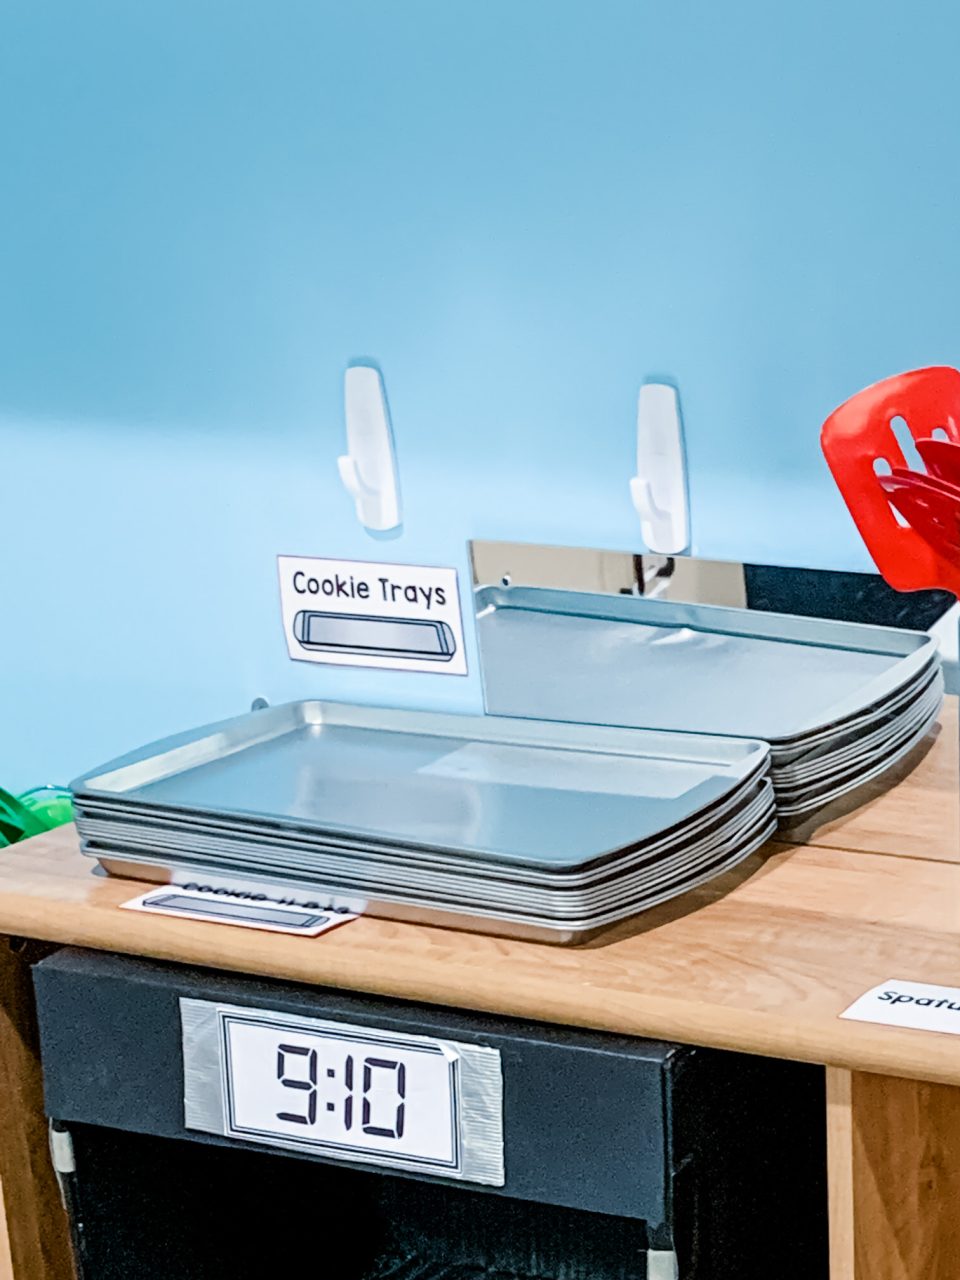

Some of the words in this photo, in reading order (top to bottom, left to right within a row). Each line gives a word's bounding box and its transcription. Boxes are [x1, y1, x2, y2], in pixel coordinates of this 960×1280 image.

[293, 571, 370, 599] Cookie
[378, 577, 446, 610] Trays
[276, 1043, 406, 1139] 9:10
